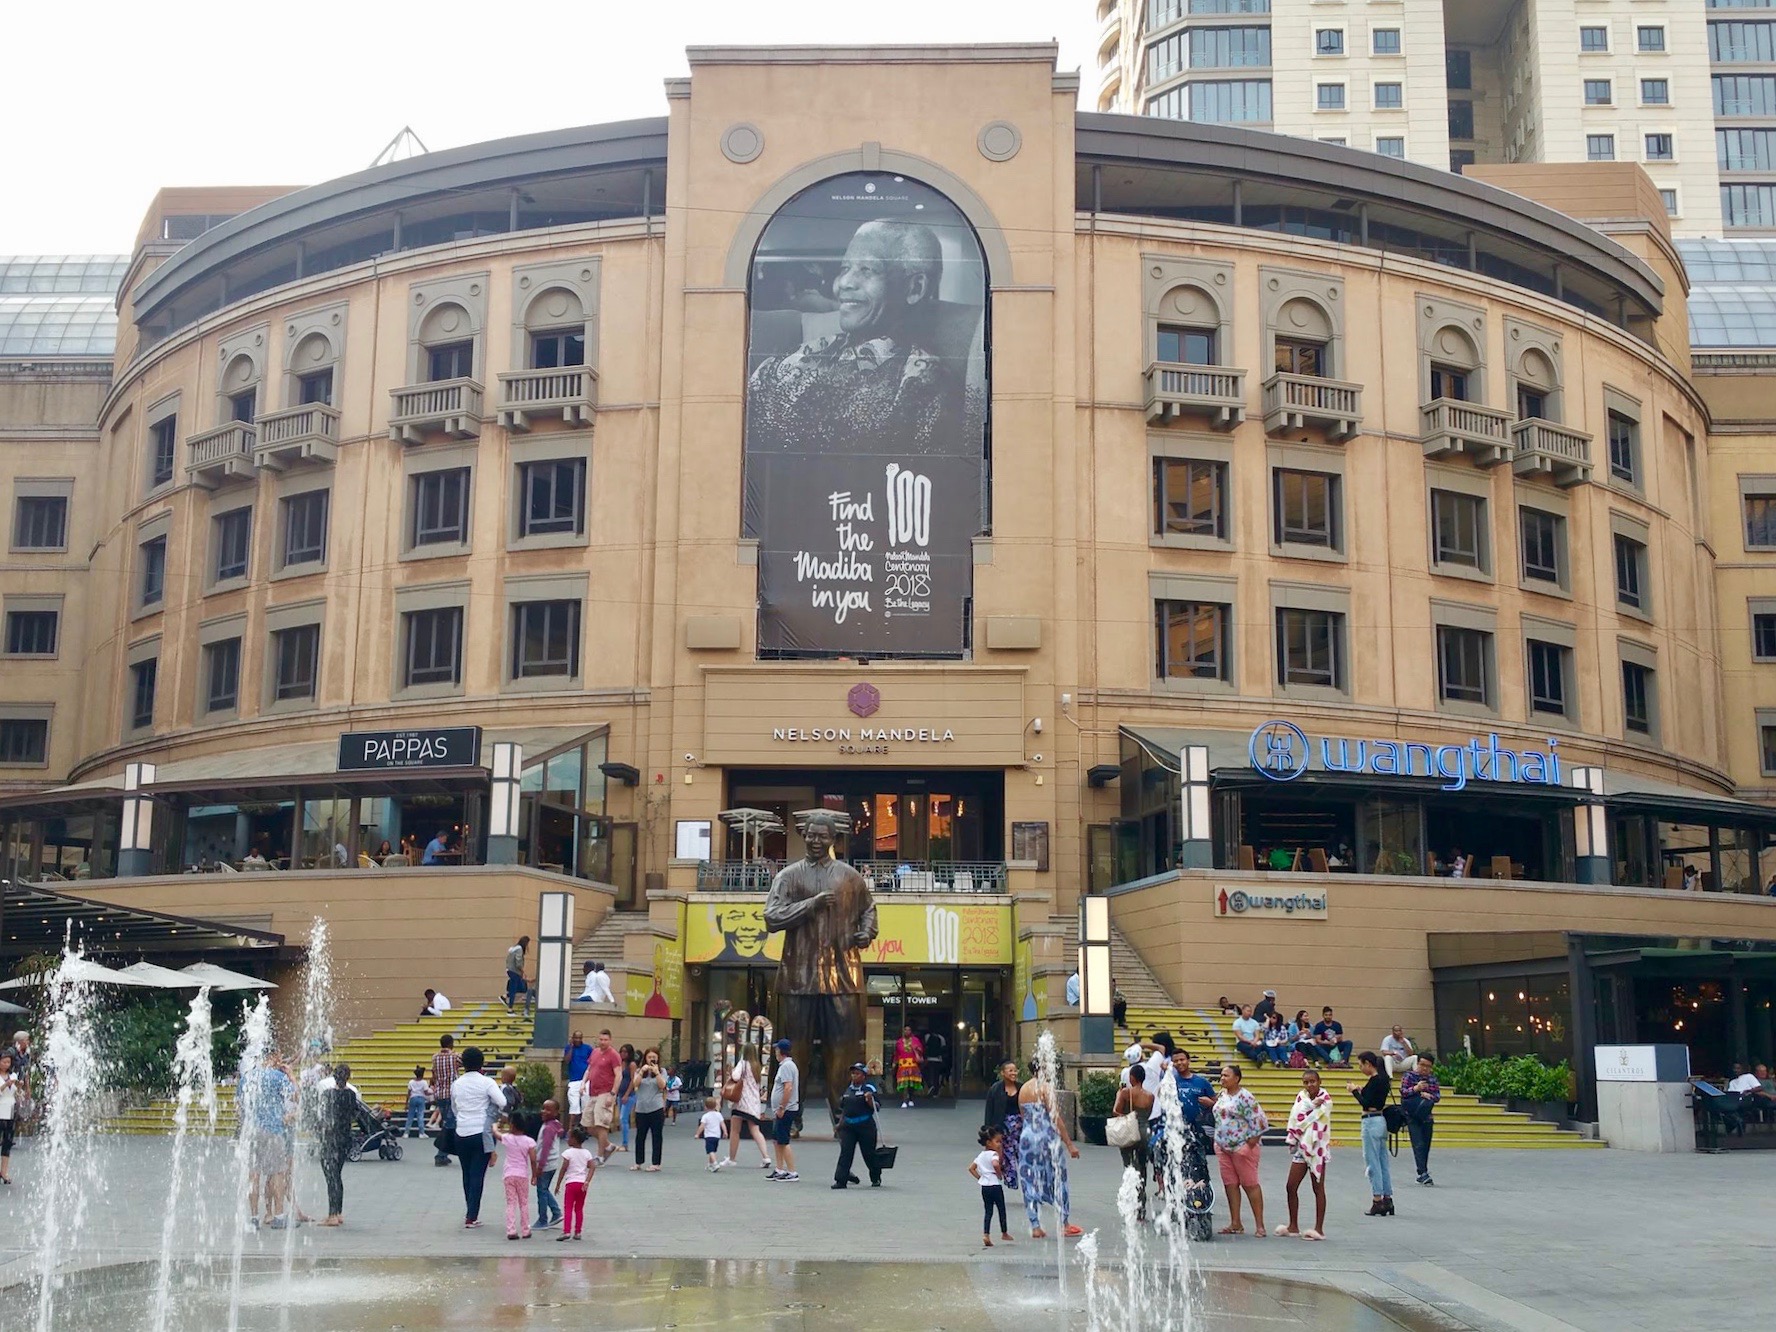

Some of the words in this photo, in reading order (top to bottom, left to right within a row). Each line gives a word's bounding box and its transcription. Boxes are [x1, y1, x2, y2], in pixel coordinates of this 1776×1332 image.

[828, 491, 875, 521] Find
[886, 462, 932, 547] 100
[836, 522, 874, 551] the
[793, 550, 874, 582] Madiba
[885, 561, 931, 580] Centenary
[884, 574, 931, 597] 2018
[812, 584, 835, 608] in
[834, 590, 872, 624] you
[773, 728, 851, 741] NELSON
[860, 728, 955, 742] MANDELA
[363, 737, 448, 761] PAPPAS
[838, 745, 889, 755] SQUARE
[1321, 733, 1561, 791] wangthai
[1249, 893, 1326, 913] wangthai
[962, 926, 999, 945] 2018
[876, 939, 905, 963] you
[882, 996, 902, 1004] WES
[906, 996, 937, 1004] TOWER
